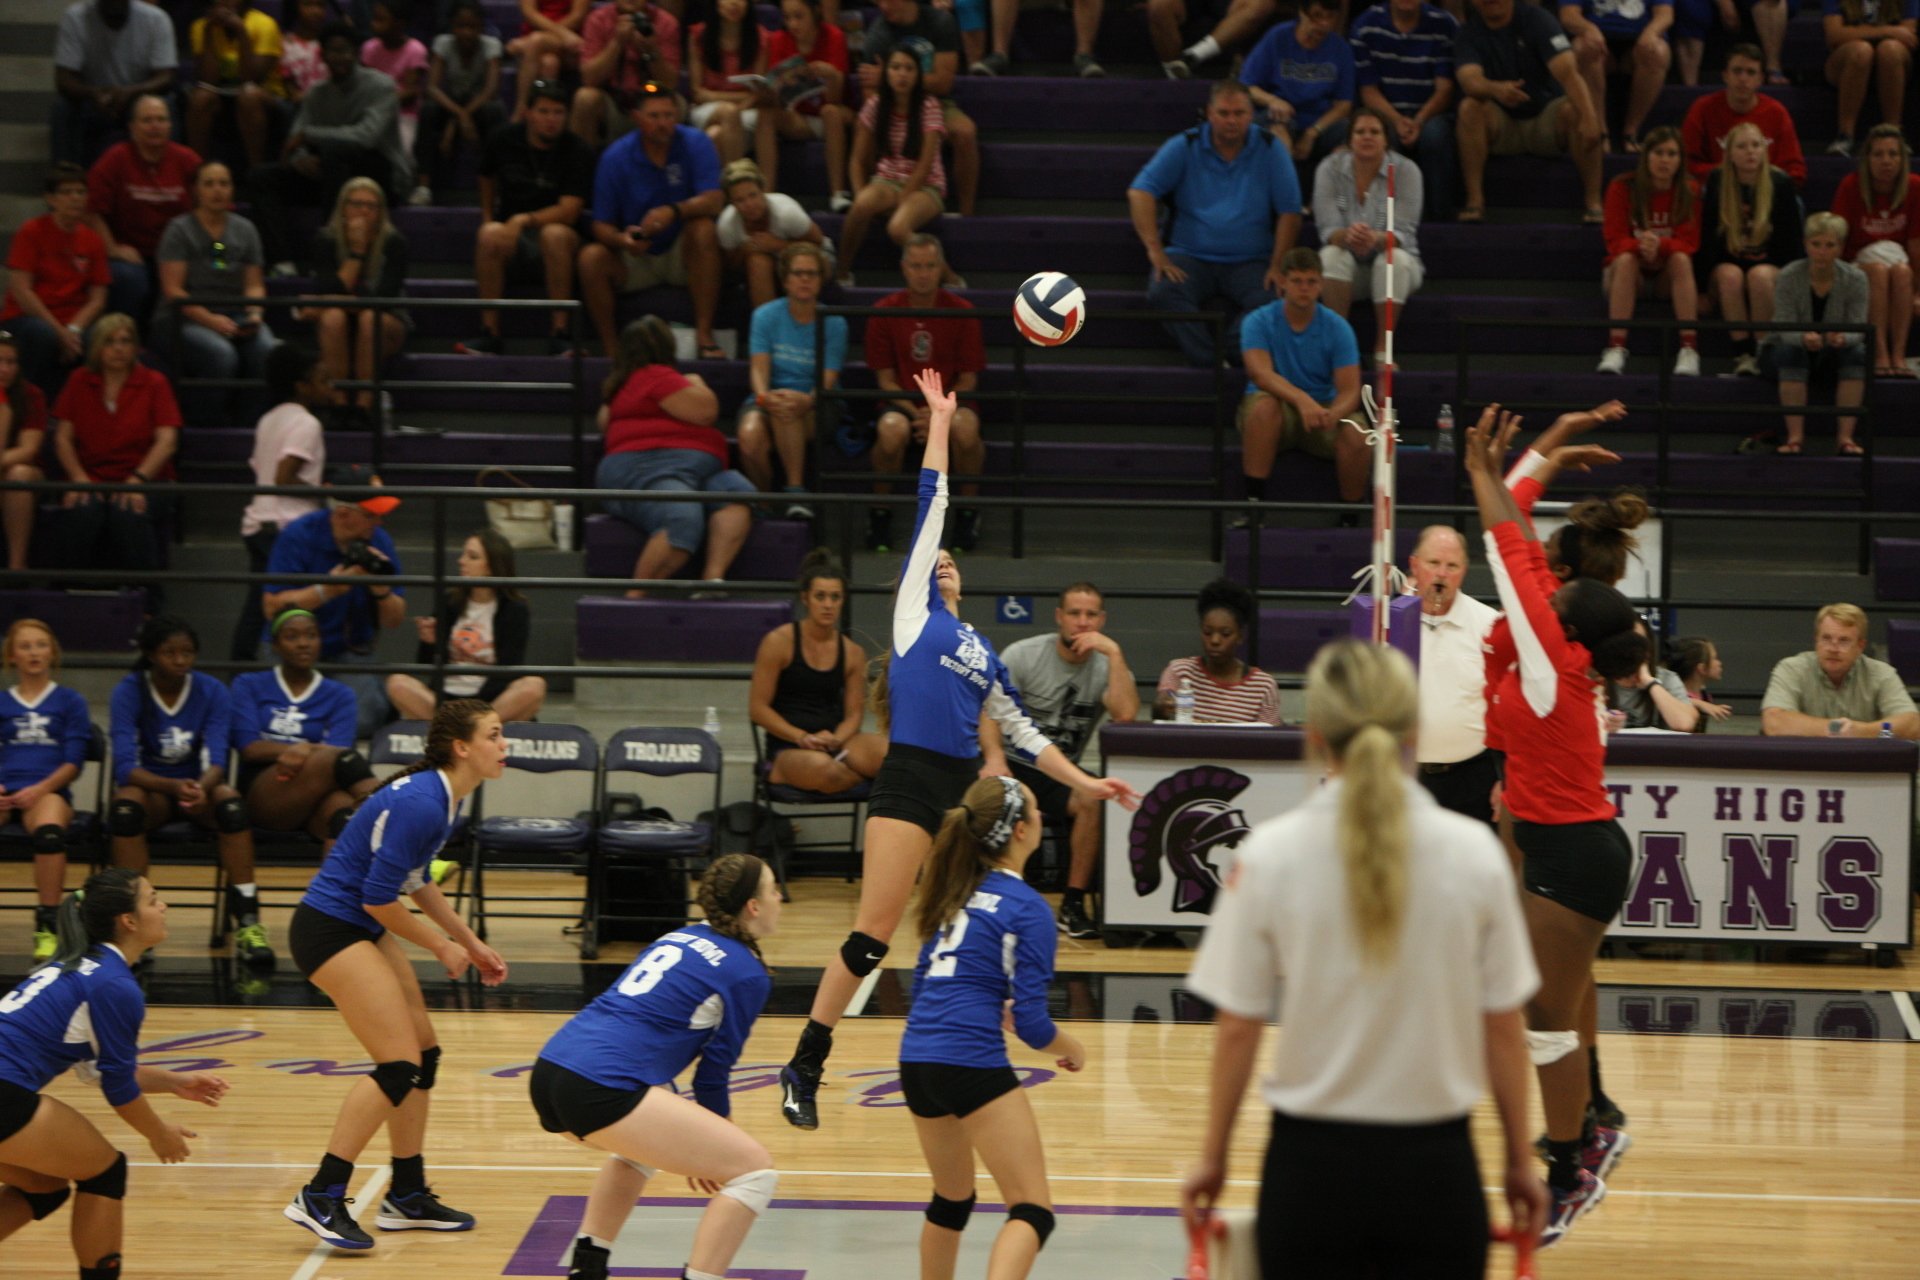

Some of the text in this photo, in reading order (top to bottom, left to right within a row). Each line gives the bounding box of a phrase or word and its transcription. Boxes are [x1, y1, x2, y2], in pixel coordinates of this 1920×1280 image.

[505, 737, 580, 760] TROJANS
[623, 741, 702, 763] TROJANS
[1714, 786, 1845, 823] HIGH
[1620, 831, 1883, 933] ANS
[925, 908, 969, 977] 2
[0, 966, 61, 1014] 3
[618, 944, 683, 996] 8
